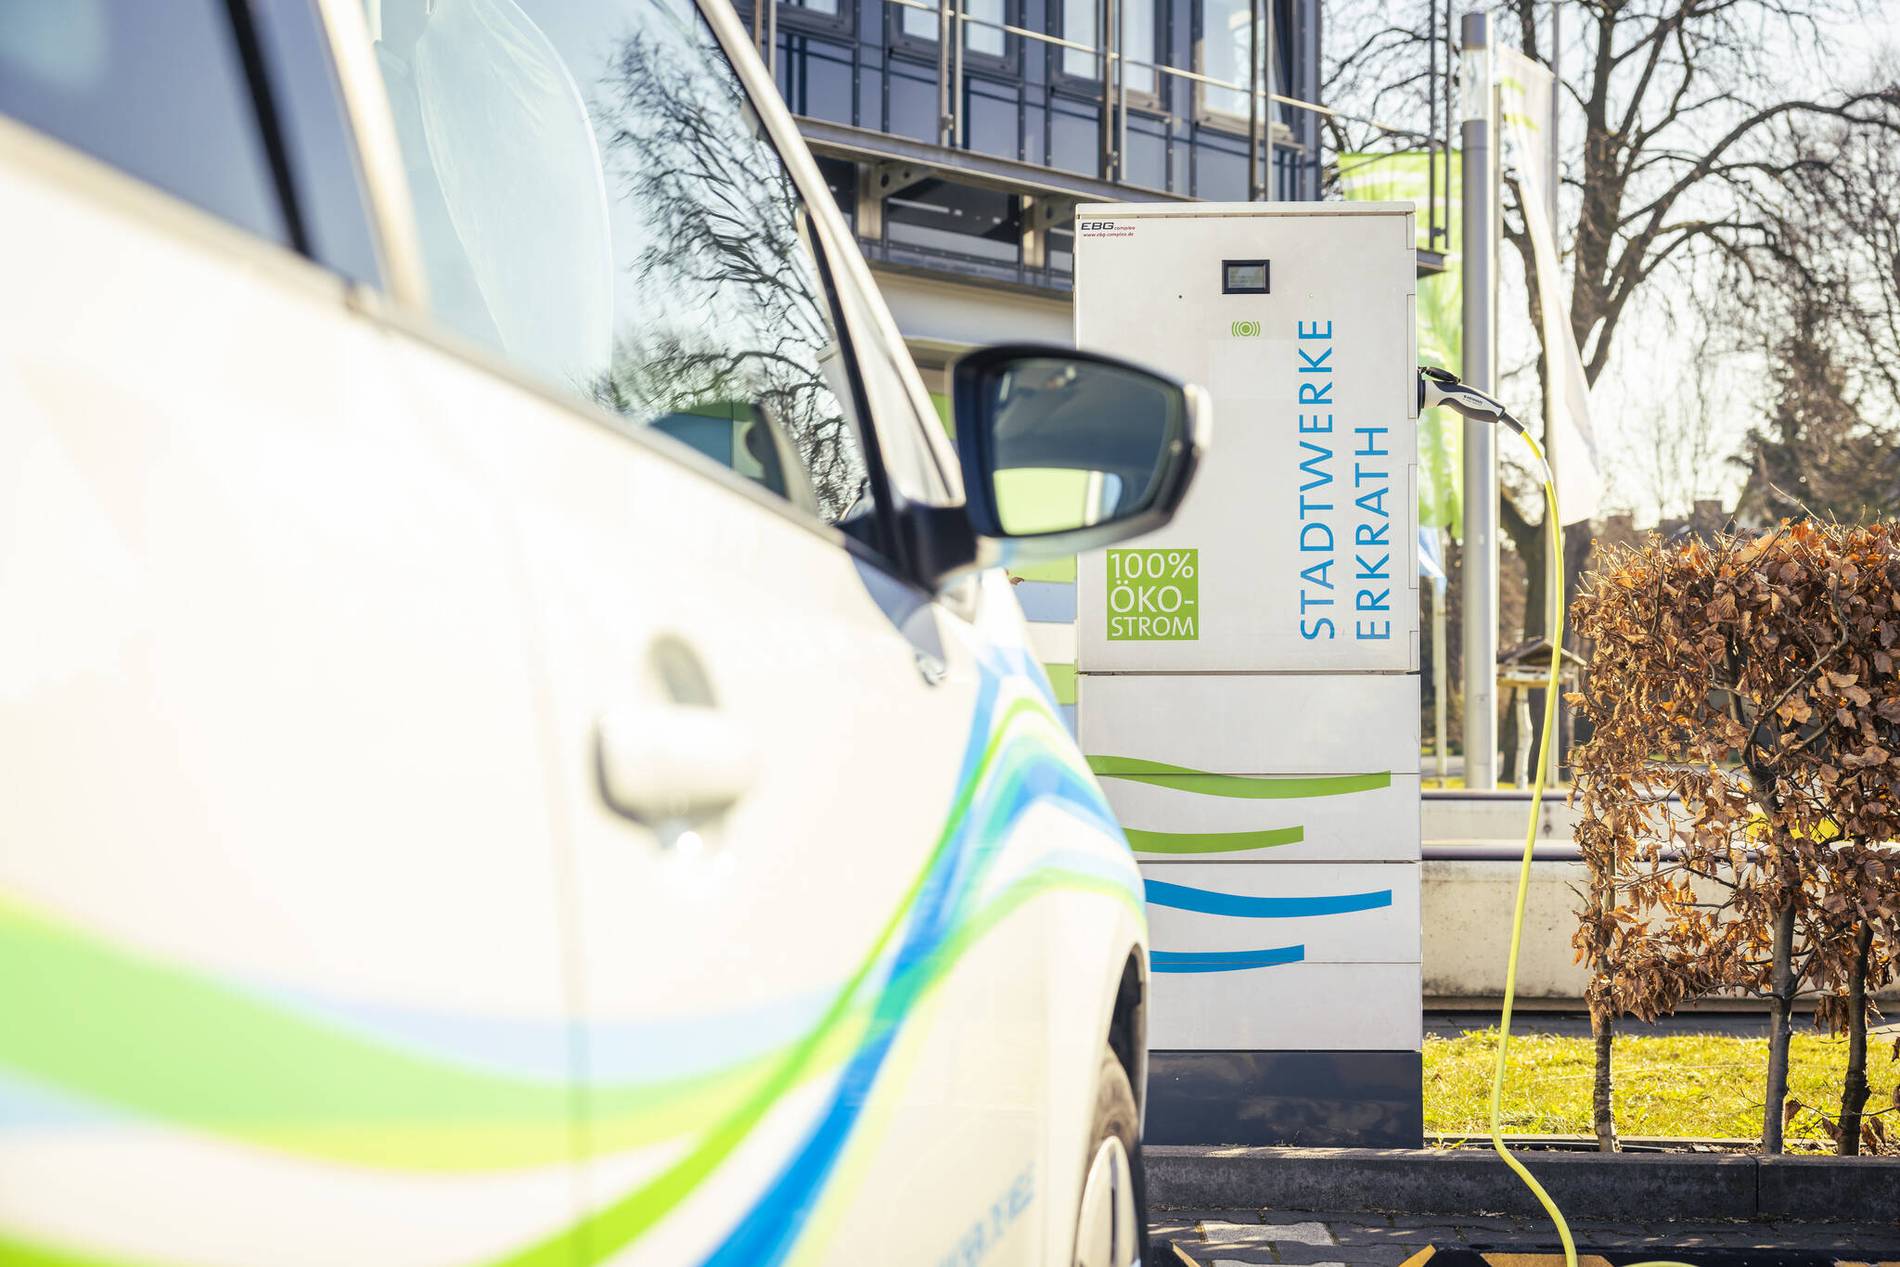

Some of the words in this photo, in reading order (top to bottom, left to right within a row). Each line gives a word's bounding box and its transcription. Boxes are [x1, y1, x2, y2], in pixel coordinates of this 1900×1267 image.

[1081, 222, 1114, 230] EBG
[1298, 320, 1335, 640] STADTWERKE
[1354, 427, 1391, 640] ERKRATH
[1110, 552, 1194, 578] 100%
[1110, 580, 1194, 613] ÖKO-
[1111, 616, 1194, 636] STROM
